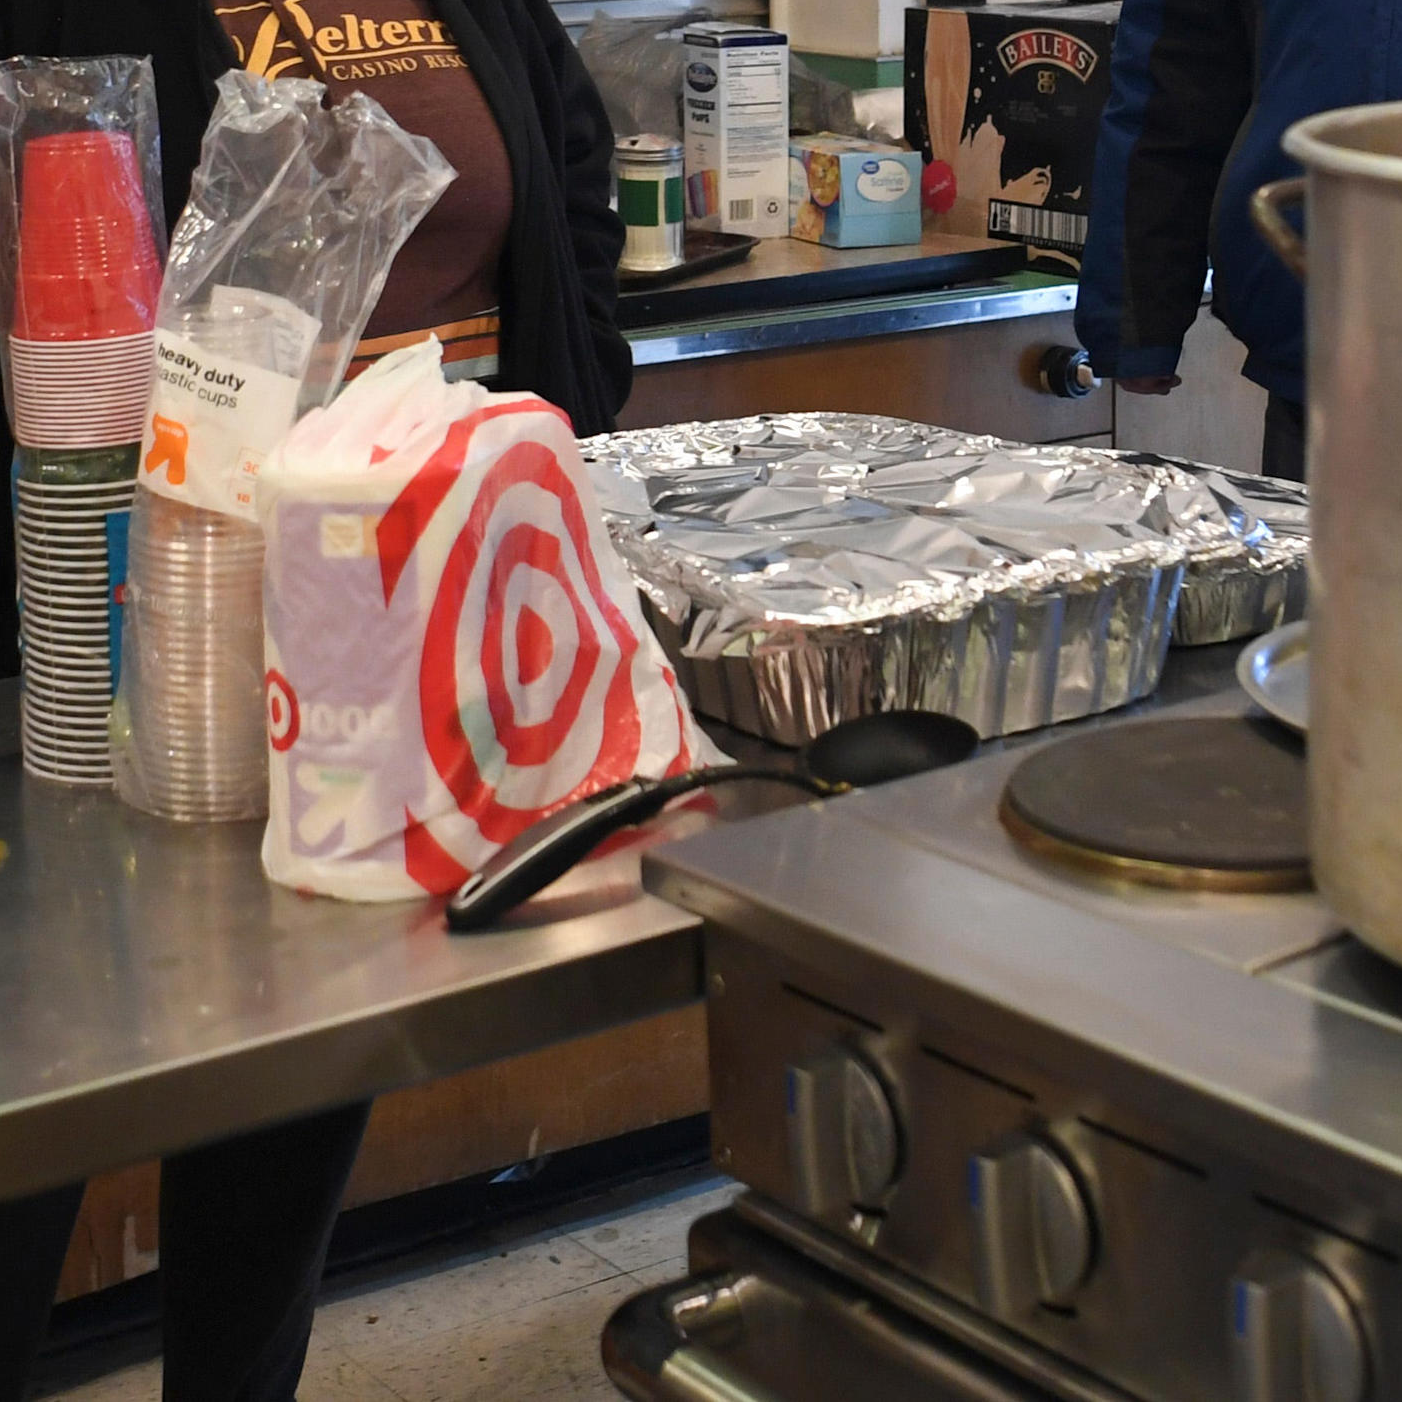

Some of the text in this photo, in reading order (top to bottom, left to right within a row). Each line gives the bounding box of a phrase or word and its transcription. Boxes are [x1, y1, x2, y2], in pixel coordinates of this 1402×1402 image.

[1004, 35, 1089, 70] BAILEYS
[331, 57, 418, 81] CASINO
[157, 343, 246, 392] heavy duty
[197, 385, 238, 409] cups
